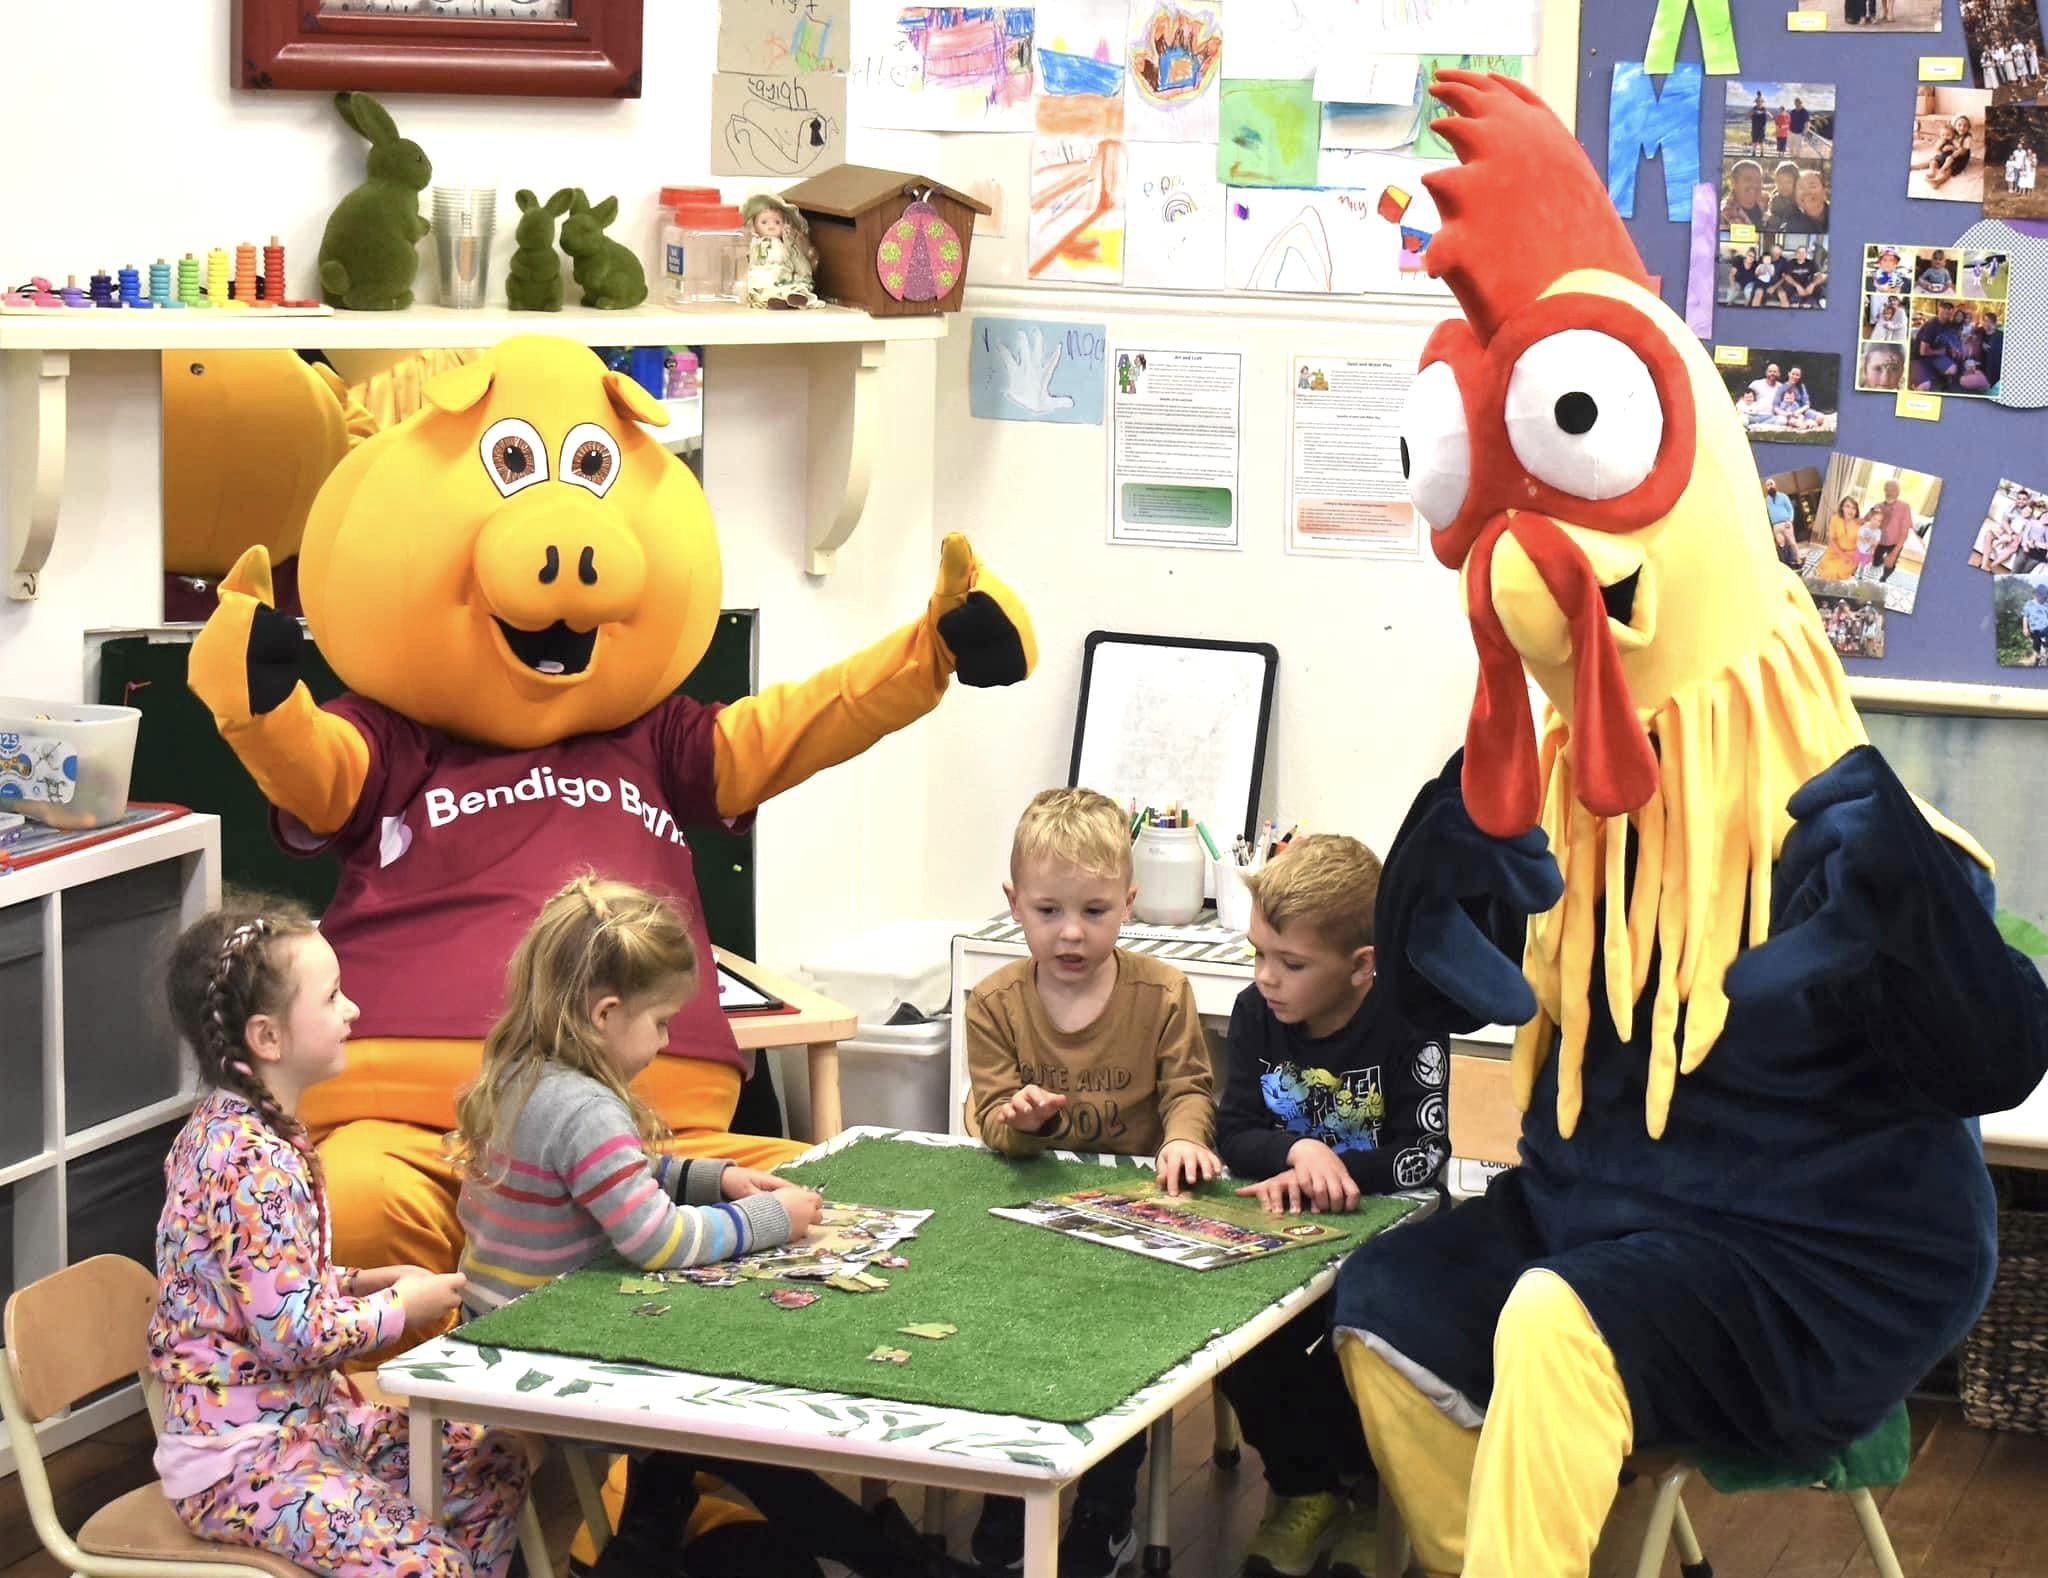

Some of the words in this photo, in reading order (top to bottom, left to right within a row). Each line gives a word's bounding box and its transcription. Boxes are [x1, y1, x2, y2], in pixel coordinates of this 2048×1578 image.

[424, 766, 612, 828] Bendigo
[619, 777, 688, 849] Ban
[1020, 1063, 1070, 1092] CUTE
[1074, 1066, 1133, 1093] AND
